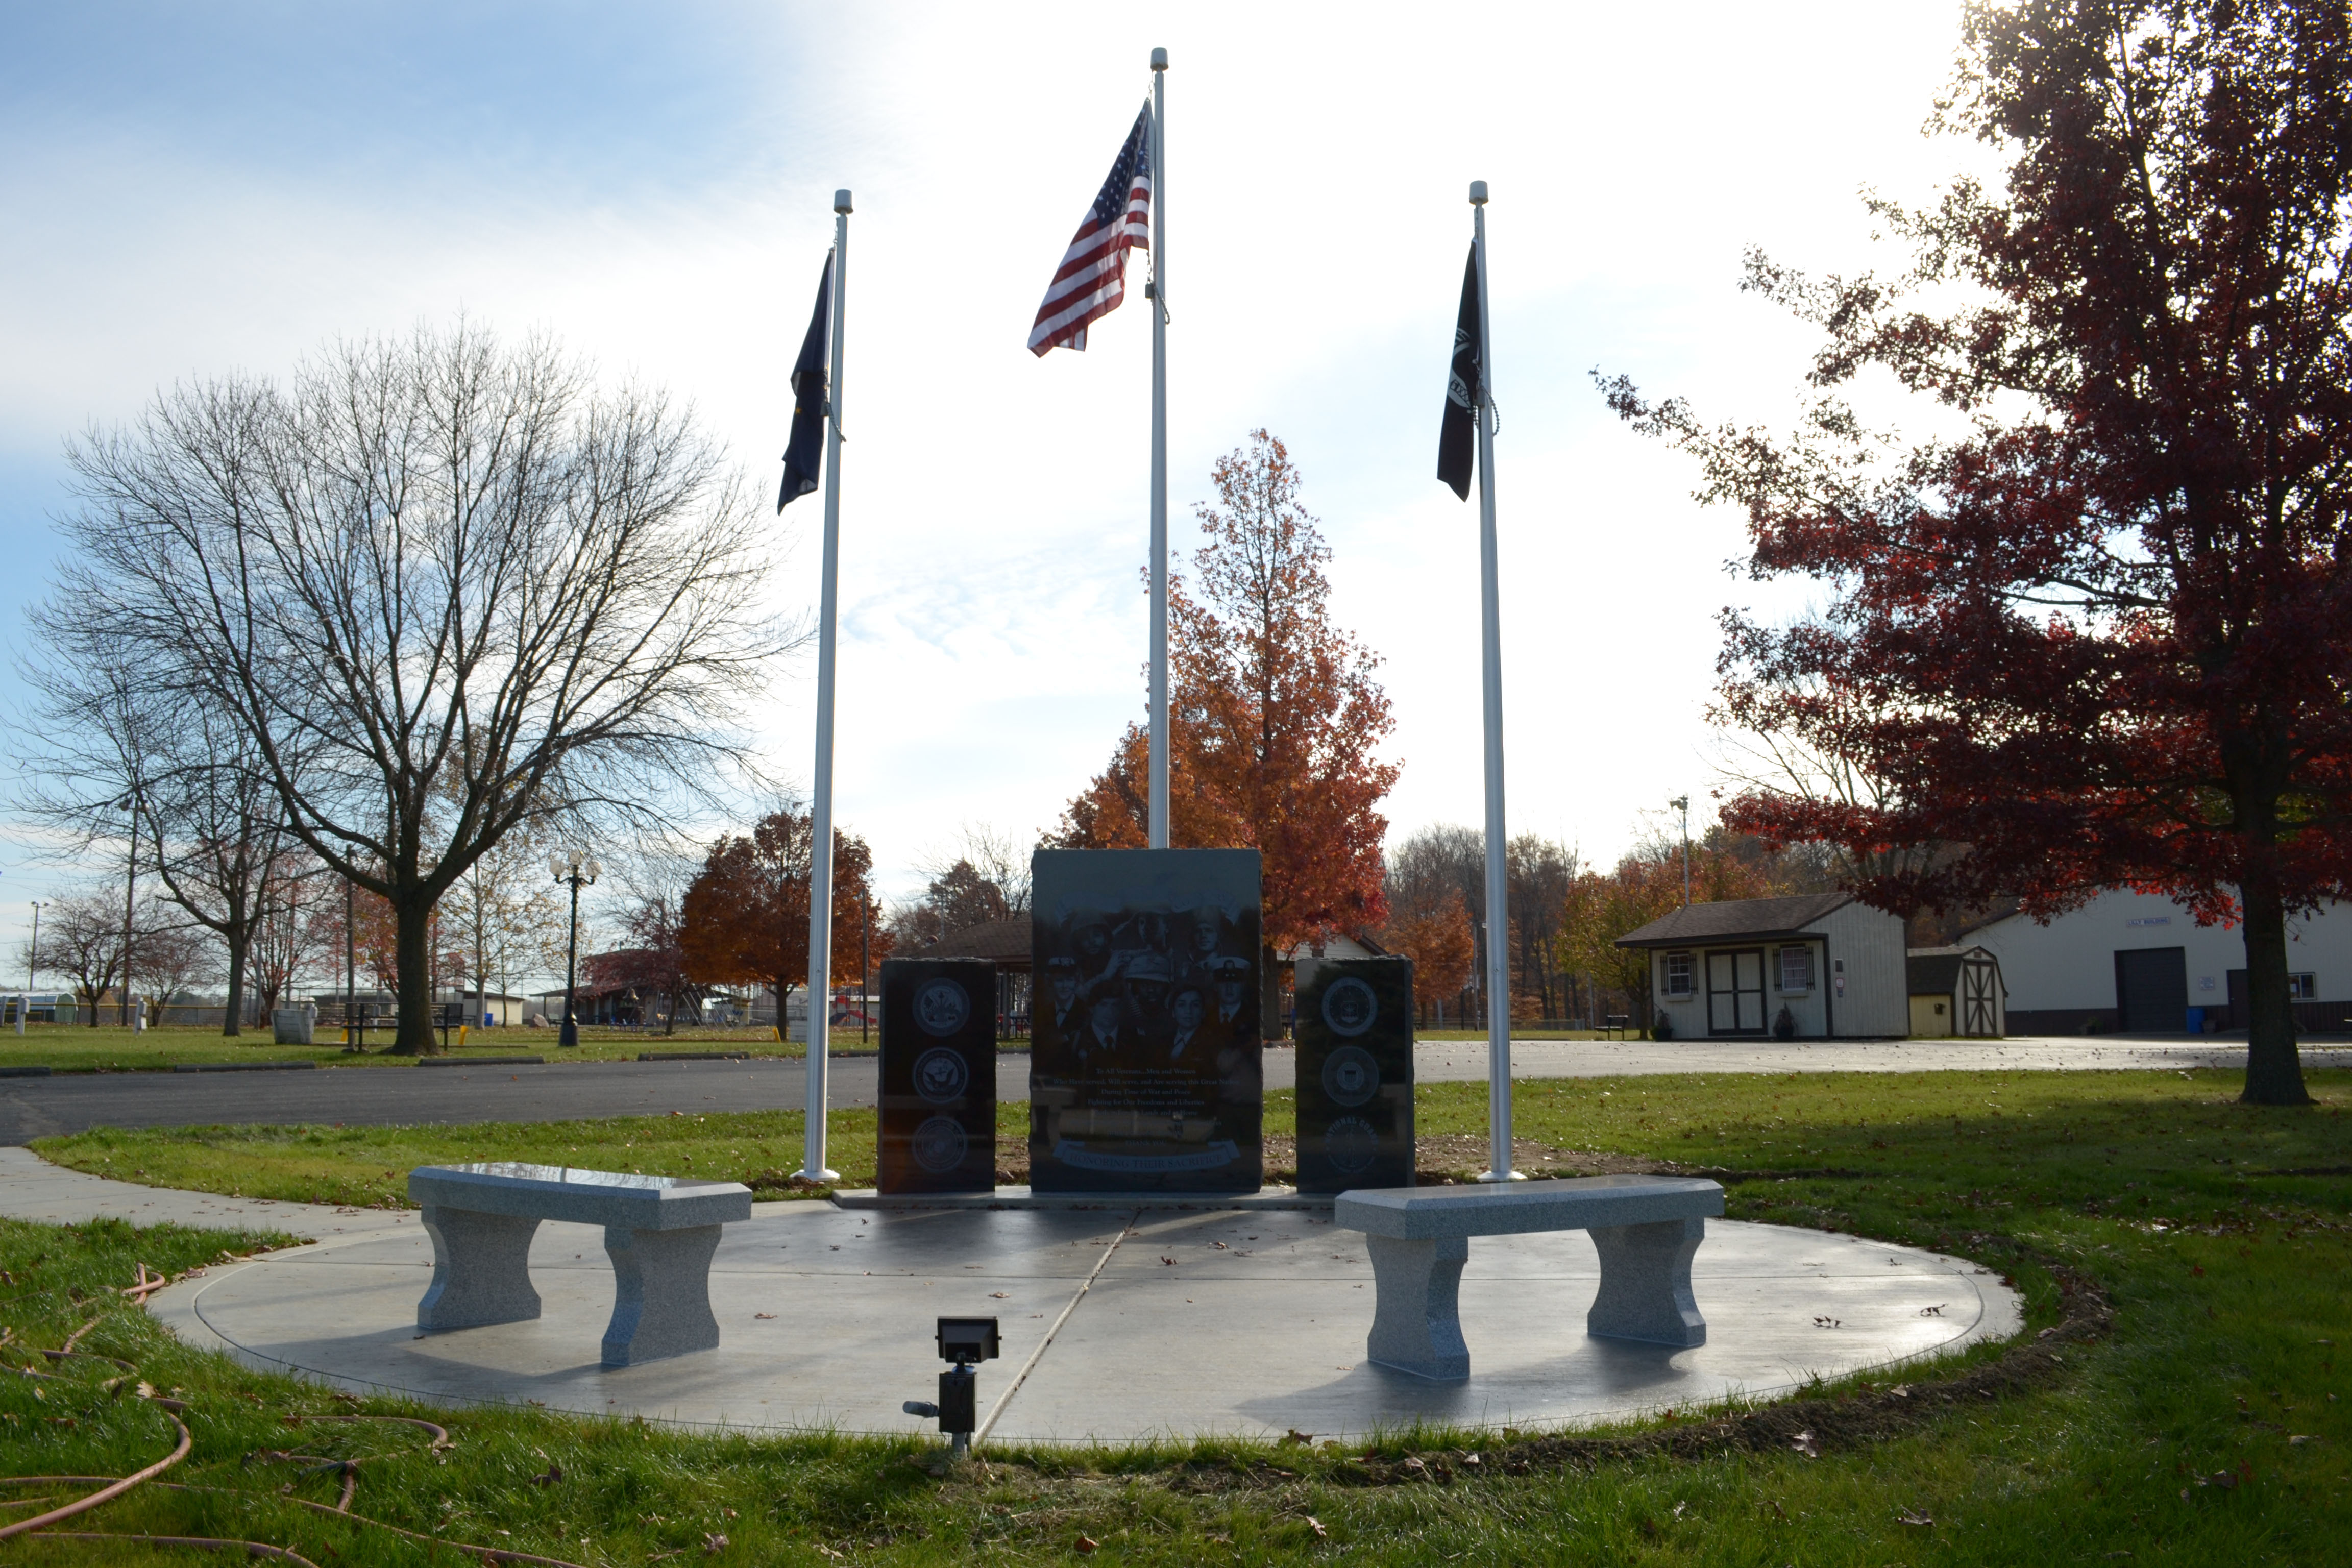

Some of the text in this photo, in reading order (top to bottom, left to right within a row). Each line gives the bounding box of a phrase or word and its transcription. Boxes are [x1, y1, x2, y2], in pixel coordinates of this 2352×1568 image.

[1166, 1078, 1188, 1086] serving
[1088, 1098, 1112, 1107] Fighting
[1325, 1116, 1379, 1145] NATIONAL GUARD
[1070, 1153, 1221, 1168] HONORING THEIR SACRIFICE
